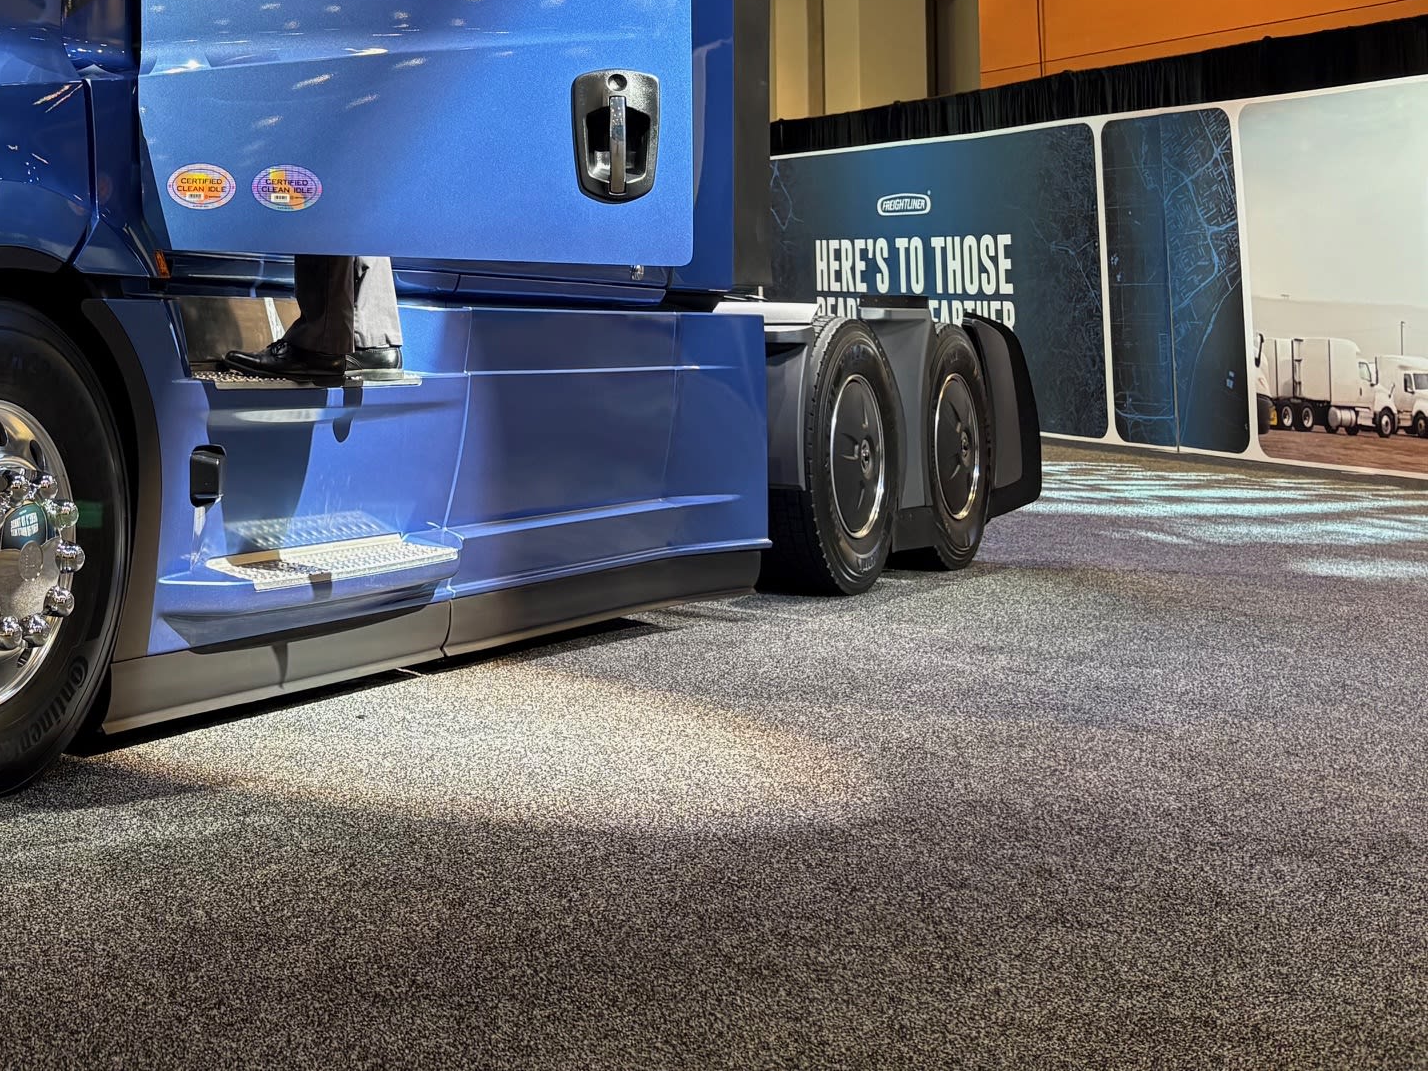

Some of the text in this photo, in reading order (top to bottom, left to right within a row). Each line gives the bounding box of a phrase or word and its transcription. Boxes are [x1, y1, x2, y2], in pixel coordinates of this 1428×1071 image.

[180, 177, 223, 185] CERTIFIED
[265, 178, 309, 186] CERTIFIED
[176, 185, 205, 193] CLEAN
[261, 186, 290, 194] CLEAN
[882, 198, 926, 212] FREIGHTLINER
[815, 234, 1014, 296] HERE'S TO THOSE
